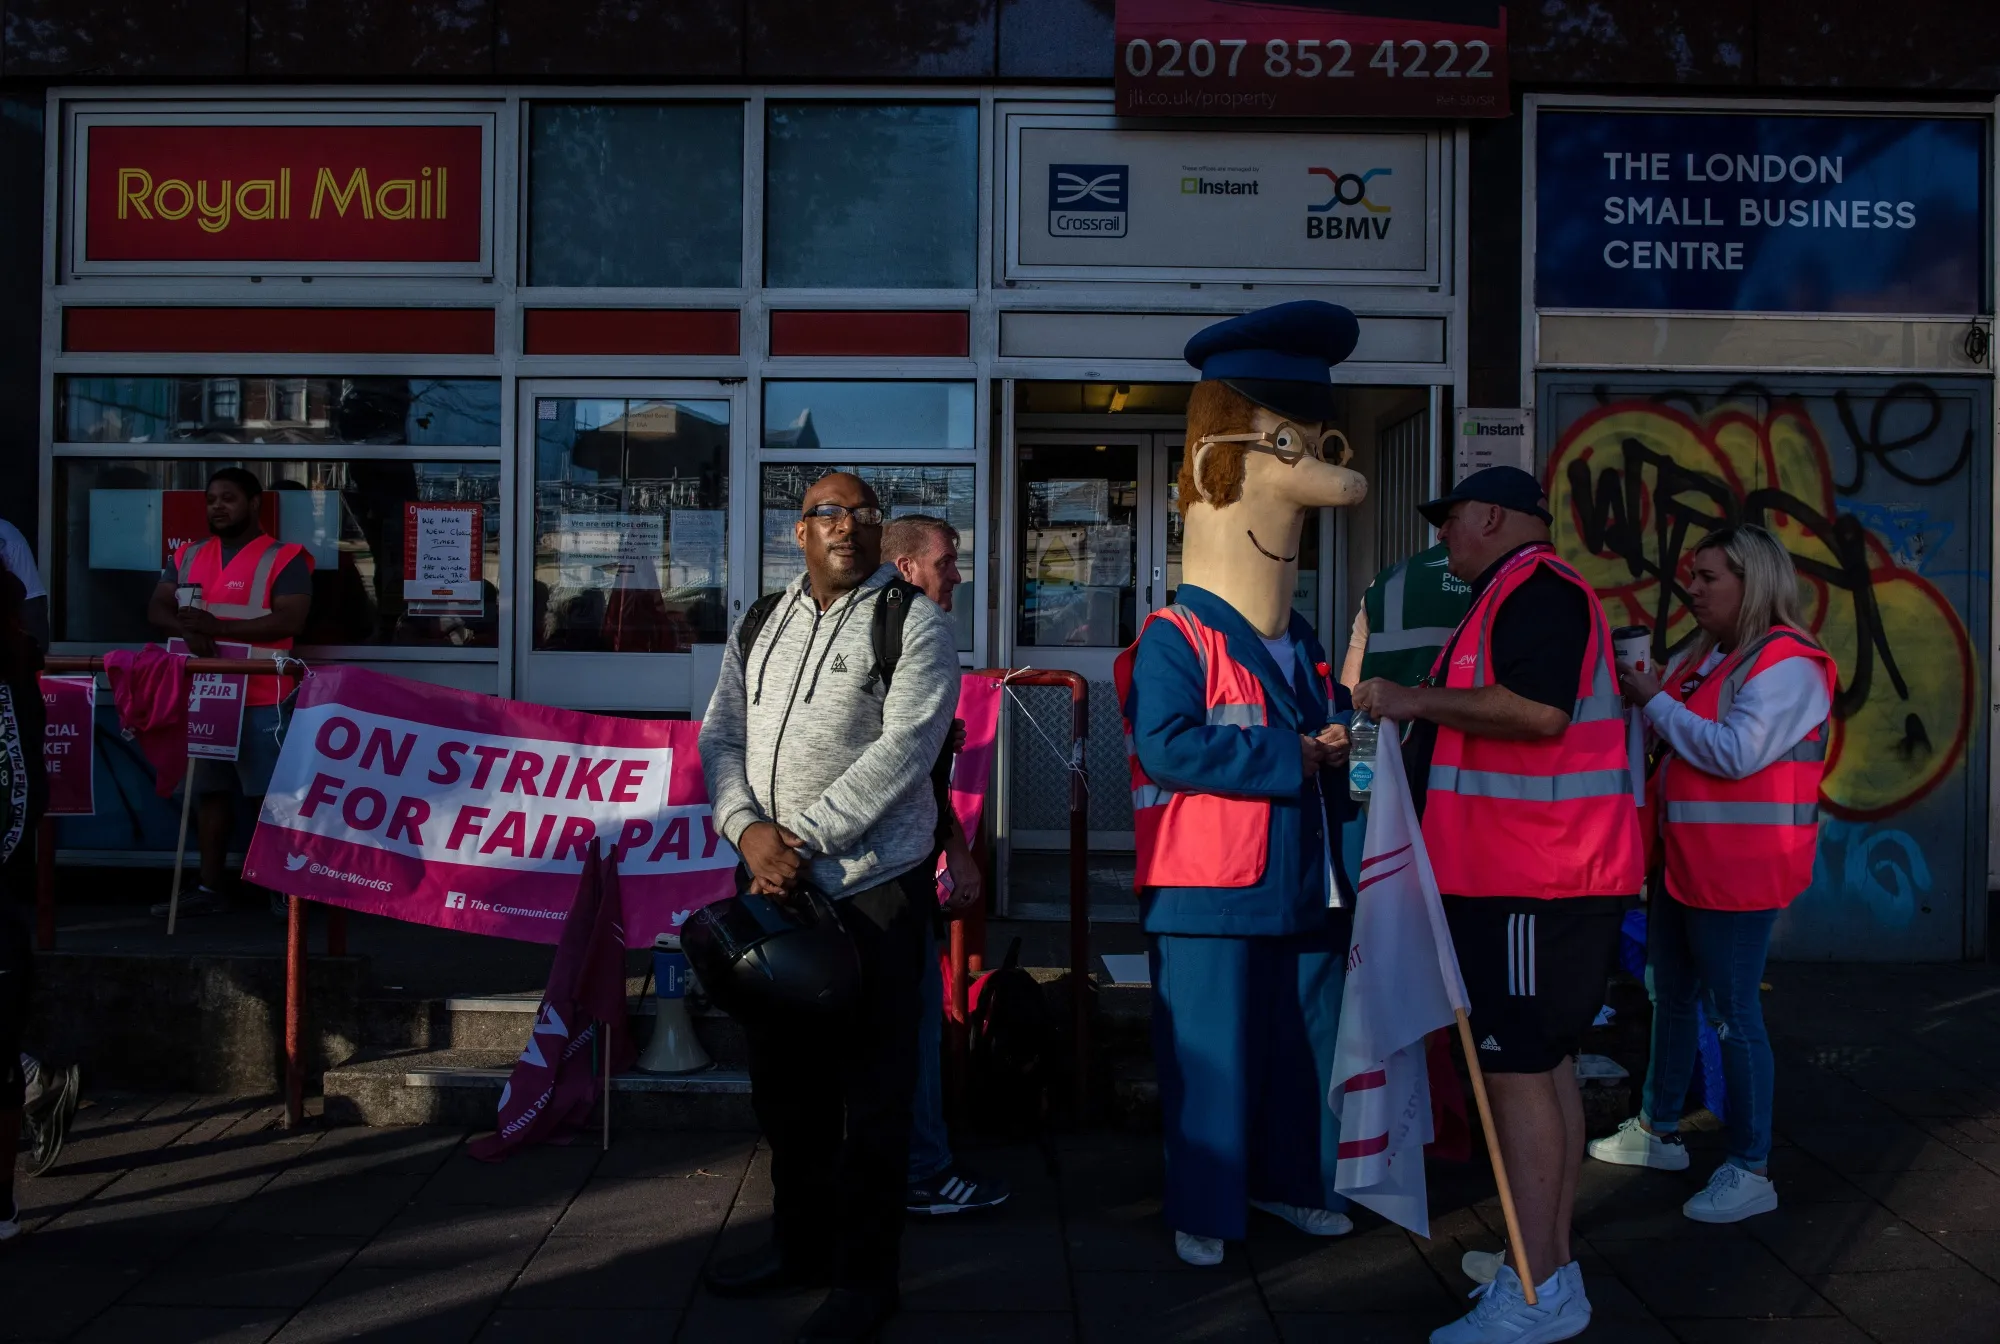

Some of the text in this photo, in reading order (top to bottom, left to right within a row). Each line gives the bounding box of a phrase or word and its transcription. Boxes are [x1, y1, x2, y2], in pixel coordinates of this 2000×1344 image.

[1125, 38, 1495, 79] 0207 852 4222
[1603, 151, 1844, 185] THE LONDON
[117, 166, 448, 234] Royal Mail
[1199, 177, 1259, 195] Instant
[1056, 214, 1121, 232] Crossrail
[1603, 196, 1917, 230] SMALL BUSINESS
[1306, 216, 1392, 240] BBMV
[1603, 240, 1745, 271] CENTRE
[1477, 422, 1525, 436] Instant
[571, 520, 585, 528] We
[600, 520, 614, 528] not
[615, 521, 635, 529] Post
[635, 521, 659, 530] office
[199, 685, 232, 697] FAIR
[314, 715, 651, 803] ON STRIKE
[13, 772, 27, 800] FILA
[298, 772, 722, 864] FOR FAIR PAY
[309, 862, 394, 893] @DaveWardGS
[469, 899, 490, 912] The
[1480, 1043, 1502, 1052] adidas
